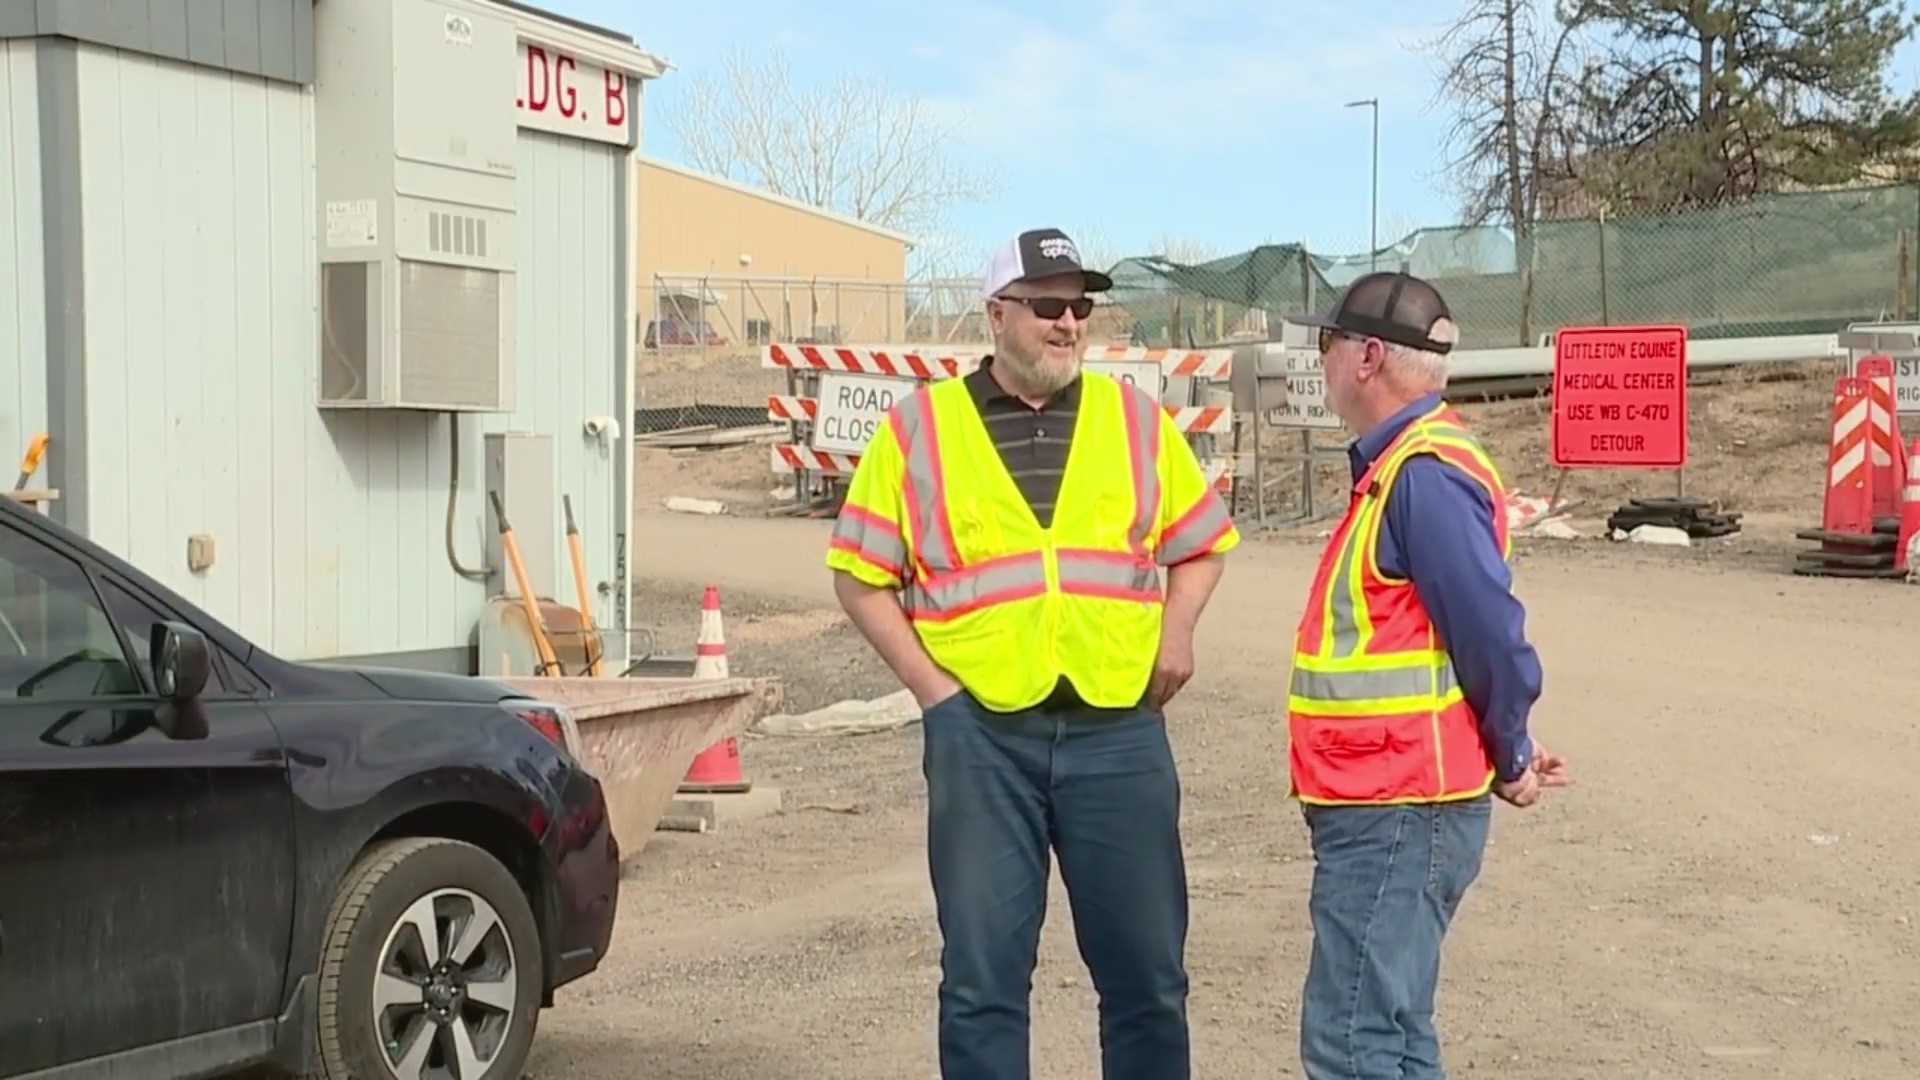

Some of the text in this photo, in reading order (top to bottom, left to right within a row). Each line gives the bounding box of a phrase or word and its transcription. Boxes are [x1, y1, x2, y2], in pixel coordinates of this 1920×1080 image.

[516, 45, 625, 126] DG. B
[1564, 342, 1677, 359] LITTLETON EQUINE
[1286, 379, 1323, 395] MUST
[1564, 373, 1675, 390] MEDICAL CENTER
[838, 386, 894, 412] ROAD
[1567, 404, 1669, 420] USE WB C-470
[823, 416, 882, 443] CLOS
[1590, 434, 1645, 451] DETOUR
